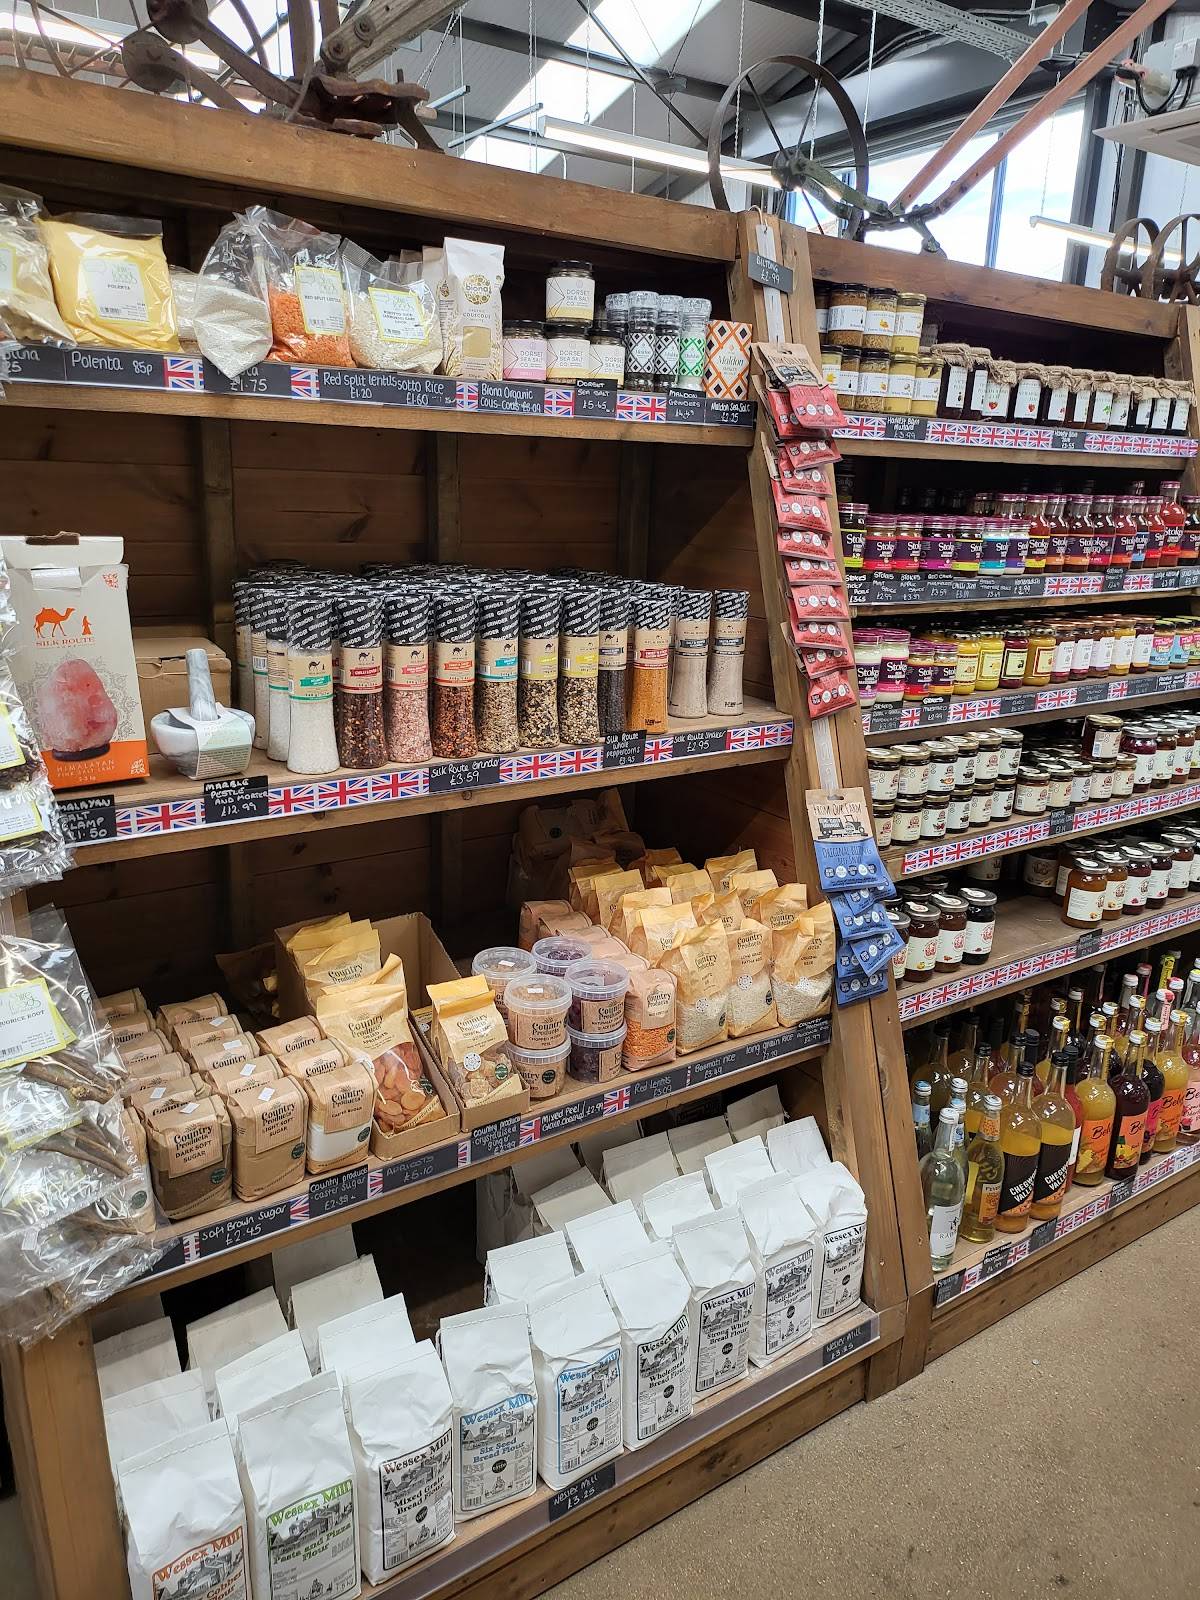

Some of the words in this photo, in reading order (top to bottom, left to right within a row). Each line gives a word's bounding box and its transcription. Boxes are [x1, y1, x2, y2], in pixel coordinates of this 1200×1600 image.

[756, 256, 779, 273] BILTONG
[760, 270, 780, 284] £2.99
[71, 351, 124, 371] Polenta
[132, 360, 153, 375] 85p
[716, 354, 744, 367] Maldon
[230, 378, 268, 393] £1.75
[323, 372, 342, 386] Red
[344, 374, 367, 391] split
[368, 372, 397, 388] lentils
[425, 380, 444, 395] Rice
[576, 380, 606, 389] DORSET
[350, 388, 373, 400] £1.20
[406, 392, 429, 406] £1.60
[481, 383, 503, 398] Biona
[504, 386, 534, 402] Organic
[668, 390, 698, 398] MALDON
[710, 402, 729, 412] Maldon
[845, 574, 867, 582] STOKES
[62, 636, 96, 645] ROUTE
[606, 734, 618, 744] Silk
[674, 734, 686, 744] Silk
[686, 740, 710, 753] £2.95
[56, 760, 114, 773] HIMALAYAN
[618, 756, 636, 766] £3.95
[432, 766, 448, 778] Silk
[448, 763, 470, 774] Route
[450, 771, 480, 784] £3.59
[206, 778, 249, 791] MARBLE
[210, 789, 246, 800] PESTLE
[214, 796, 236, 805] AND
[220, 802, 258, 818] £12.99
[813, 803, 831, 815] FROM
[770, 913, 796, 926] Country
[737, 932, 764, 946] Country
[737, 939, 762, 951] Products
[328, 963, 364, 979] Country
[647, 994, 672, 1006] Country
[27, 1010, 46, 1021] ROOT
[348, 1014, 384, 1032] Country
[456, 1014, 488, 1028] Country
[351, 1024, 382, 1039] Products
[532, 1028, 560, 1036] Products
[285, 1036, 316, 1054] Country
[762, 1038, 780, 1056] grain
[780, 1032, 794, 1044] Rice
[212, 1054, 248, 1070] Country
[305, 1059, 338, 1078] Country
[694, 1059, 722, 1074] Basmati
[722, 1053, 736, 1065] rice
[704, 1067, 723, 1080] £3.49
[331, 1087, 366, 1103] Country
[634, 1083, 648, 1096] Red
[332, 1096, 362, 1109] Products
[260, 1102, 296, 1122] Country
[262, 1112, 293, 1127] Products
[542, 1109, 564, 1124] Mixed
[565, 1104, 580, 1116] Peel
[586, 1102, 604, 1116] £2.99
[278, 1118, 294, 1128] SOFT
[174, 1124, 214, 1145] Country
[270, 1126, 288, 1138] SUGAR
[473, 1126, 498, 1138] Country
[175, 1148, 194, 1158] DARK
[195, 1140, 212, 1152] SOFT
[176, 1133, 209, 1151] Products
[184, 1150, 206, 1164] SUGAR
[310, 1178, 340, 1194] Country
[313, 1186, 340, 1201] caster
[341, 1176, 366, 1194] sugar
[324, 1194, 350, 1211] £2.39
[202, 1224, 225, 1241] Soft
[226, 1214, 254, 1232] Brown
[258, 1204, 288, 1224] sugar
[225, 1222, 262, 1246] £2.45
[824, 1230, 853, 1246] Wessex
[768, 1258, 798, 1279] Wessex
[797, 1249, 814, 1265] Mill
[833, 1264, 848, 1275] Plain
[704, 1292, 737, 1312] Wessex
[737, 1284, 755, 1300] Mill
[774, 1285, 807, 1306] Self-Raising
[640, 1334, 673, 1354] Wessex
[672, 1318, 687, 1339] Mill
[706, 1326, 730, 1340] Strong
[730, 1320, 750, 1334] White
[709, 1333, 730, 1346] Bread
[730, 1326, 748, 1341] Flour
[648, 1375, 670, 1390] Bread
[670, 1366, 686, 1382] Flour
[649, 1358, 686, 1383] Wholemeal
[464, 1404, 506, 1426] Wessex
[508, 1394, 534, 1412] Mill
[571, 1409, 594, 1424] Bread
[594, 1398, 614, 1416] Flour
[578, 1403, 592, 1414] Six
[590, 1394, 608, 1410] Seed
[472, 1450, 500, 1464] Bread
[501, 1440, 526, 1458] Flour
[480, 1444, 494, 1456] Six
[495, 1437, 517, 1451] Seed
[384, 1449, 427, 1476] Wessex
[429, 1434, 450, 1456] Mill
[580, 1474, 600, 1490] Mill
[393, 1488, 423, 1510] Mixed
[424, 1474, 446, 1494] Grain
[396, 1499, 424, 1516] Bread
[424, 1482, 444, 1500] Flour
[567, 1486, 596, 1510] £3.25
[270, 1494, 320, 1528] Wessex
[322, 1480, 353, 1504] Mill
[272, 1550, 300, 1566] Pasta
[300, 1539, 323, 1554] and
[326, 1522, 352, 1542] Pizza
[154, 1547, 210, 1583] Wessex
[210, 1529, 242, 1552] Mill
[302, 1543, 330, 1562] Flour
[206, 1570, 244, 1598] Cobber
